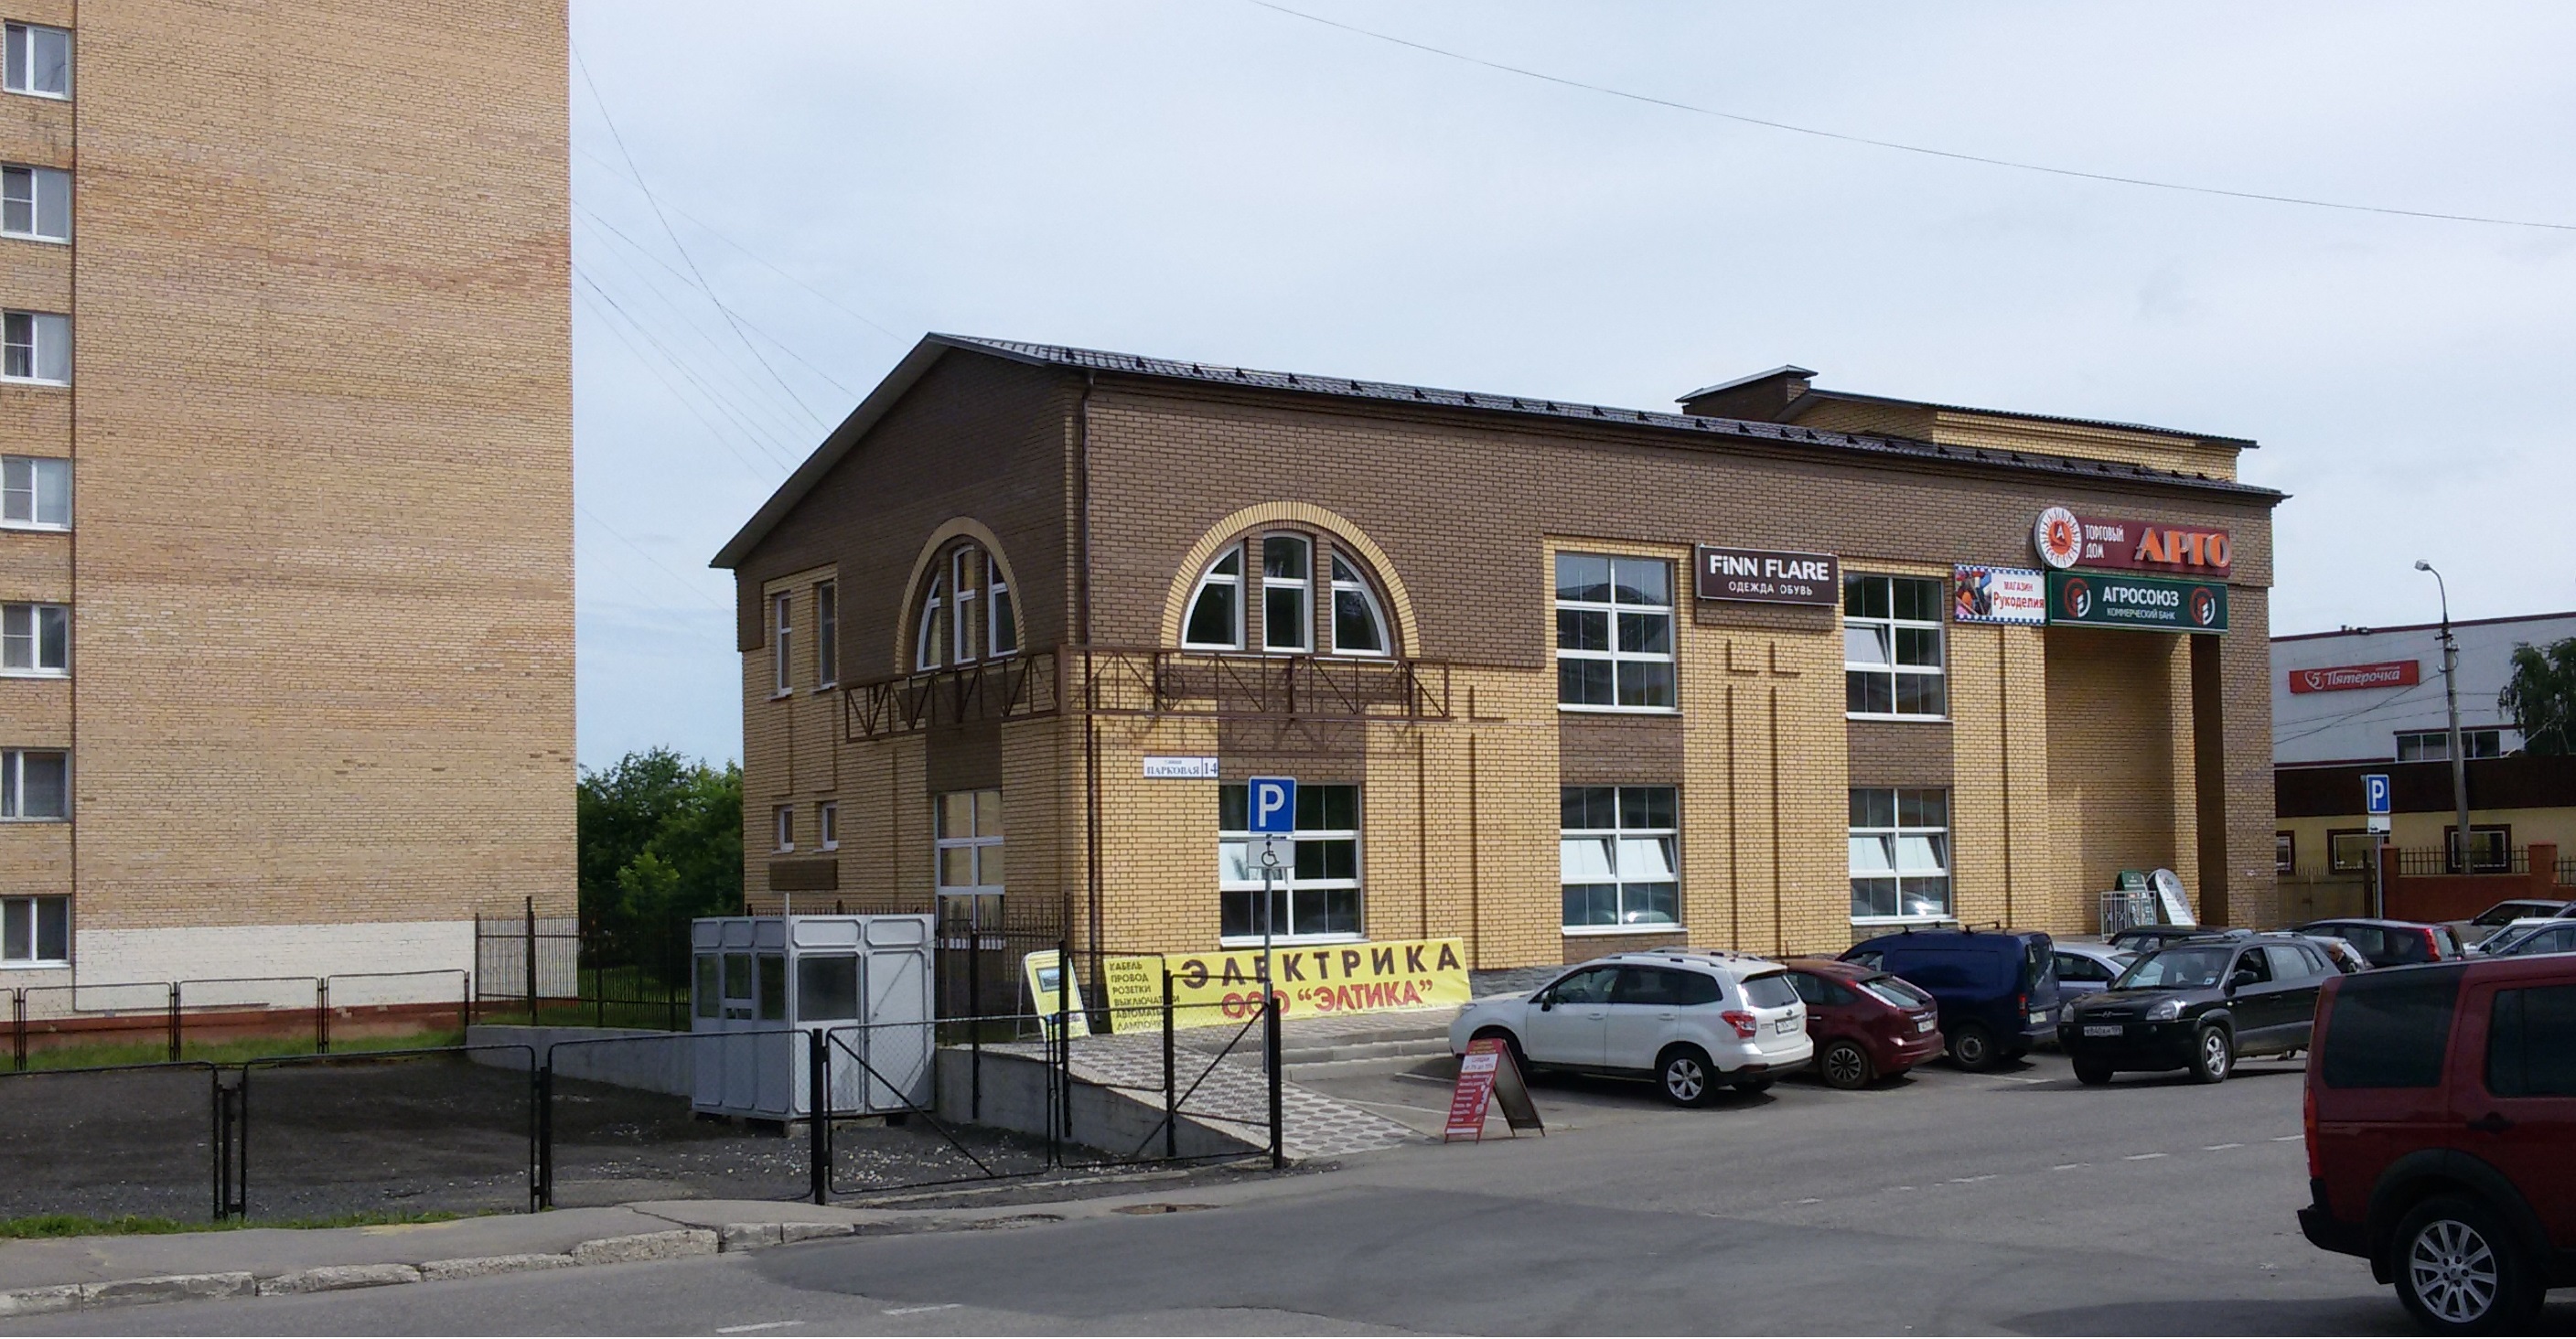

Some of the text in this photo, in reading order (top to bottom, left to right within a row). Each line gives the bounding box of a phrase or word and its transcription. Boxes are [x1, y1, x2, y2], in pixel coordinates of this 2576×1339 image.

[2085, 524, 2124, 542] ТОРГОВЫЙ
[2086, 542, 2104, 559] ДОМ
[2134, 527, 2231, 568] АРГО
[1765, 559, 1830, 581] FLARE
[1728, 581, 1813, 596] ОДЕЖДА ОБУВЬ
[2003, 581, 2034, 592] МАГАЗИН
[1993, 592, 2045, 610] Рукоделия
[2102, 586, 2179, 606] АГРОСОЮЗ
[2107, 607, 2176, 620] КОММЕРЧЕСКИЙ БАНК
[1146, 762, 1218, 775] ПАРКОВАЯ 14
[2372, 779, 2385, 809] P
[1259, 783, 1285, 828] P
[1110, 961, 1143, 971] КАБЕЛЬ
[1182, 943, 1462, 989] ЭЛЕКТРИКА
[1111, 973, 1149, 983] ПРОВОД
[1112, 986, 1152, 995] РОЗЕТКИ
[1114, 995, 1180, 1006] ВЫКЛЮЧАТИ
